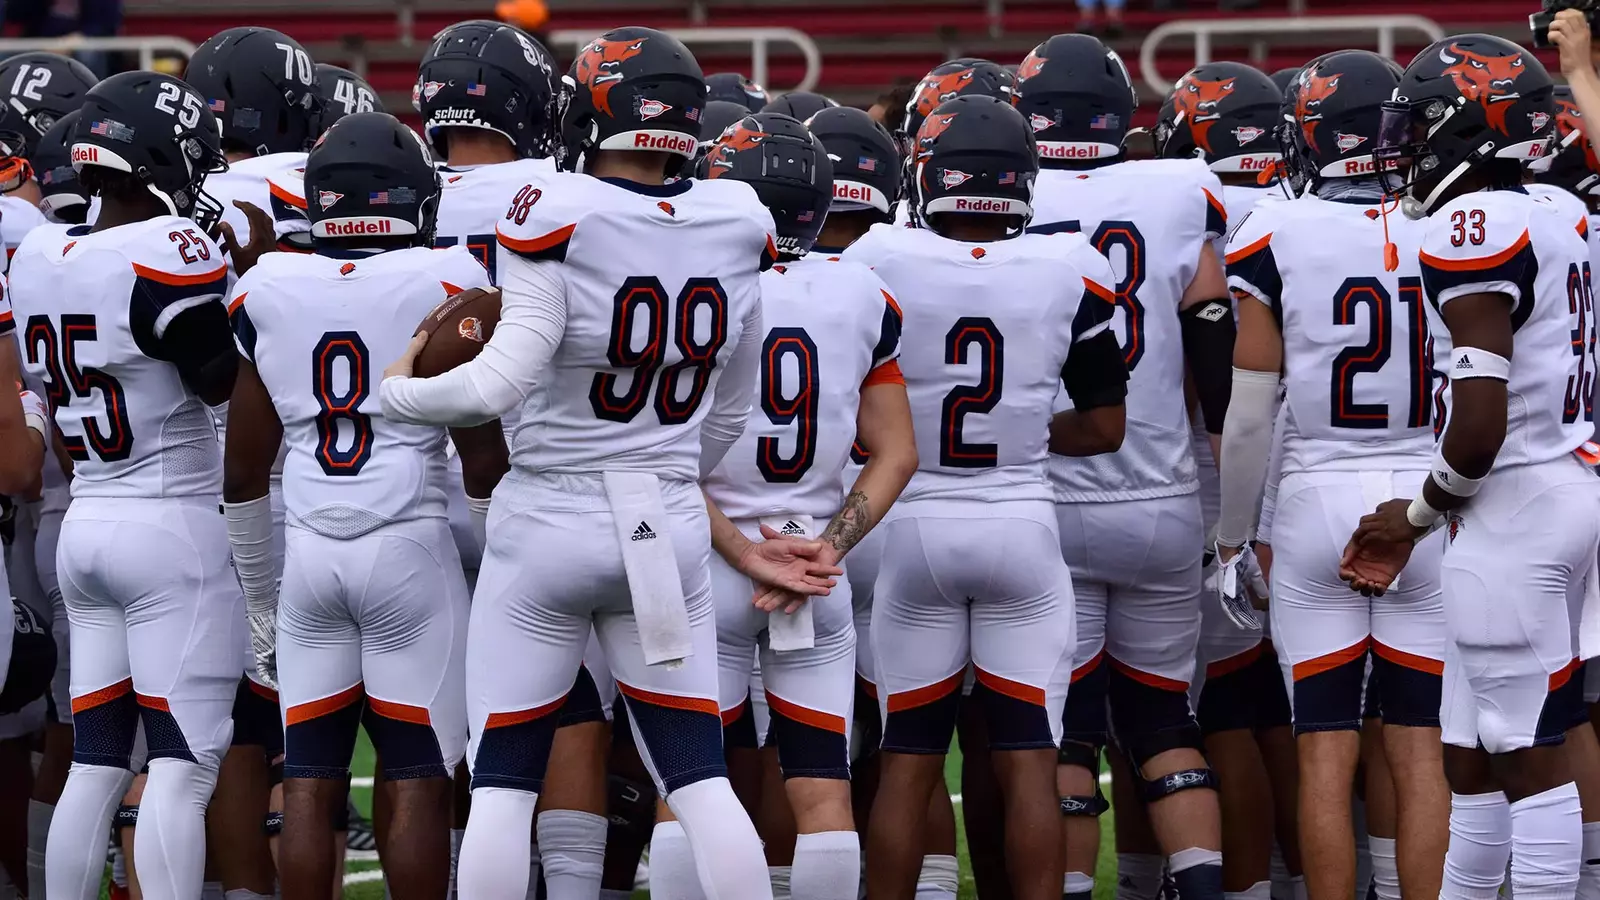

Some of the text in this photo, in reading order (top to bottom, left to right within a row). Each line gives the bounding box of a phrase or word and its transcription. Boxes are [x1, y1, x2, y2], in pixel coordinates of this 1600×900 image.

[10, 64, 52, 101] 12
[275, 43, 312, 86] 70
[154, 82, 203, 129] 25
[333, 79, 374, 115] 46
[434, 106, 476, 120] schutt
[72, 147, 98, 162] dell
[634, 132, 695, 154] Riddell
[1036, 144, 1099, 158] Riddell
[506, 184, 542, 226] 98
[956, 199, 1010, 212] Riddell
[325, 219, 390, 236] Riddell
[1450, 209, 1486, 247] 33
[168, 229, 211, 264] 25
[589, 276, 728, 425] 98
[1331, 276, 1433, 428] 21
[25, 314, 134, 462] 25
[312, 331, 374, 476] 8
[756, 327, 820, 483] 9
[940, 316, 1004, 468] 2
[631, 531, 656, 541] adidas
[781, 528, 805, 536] adidas
